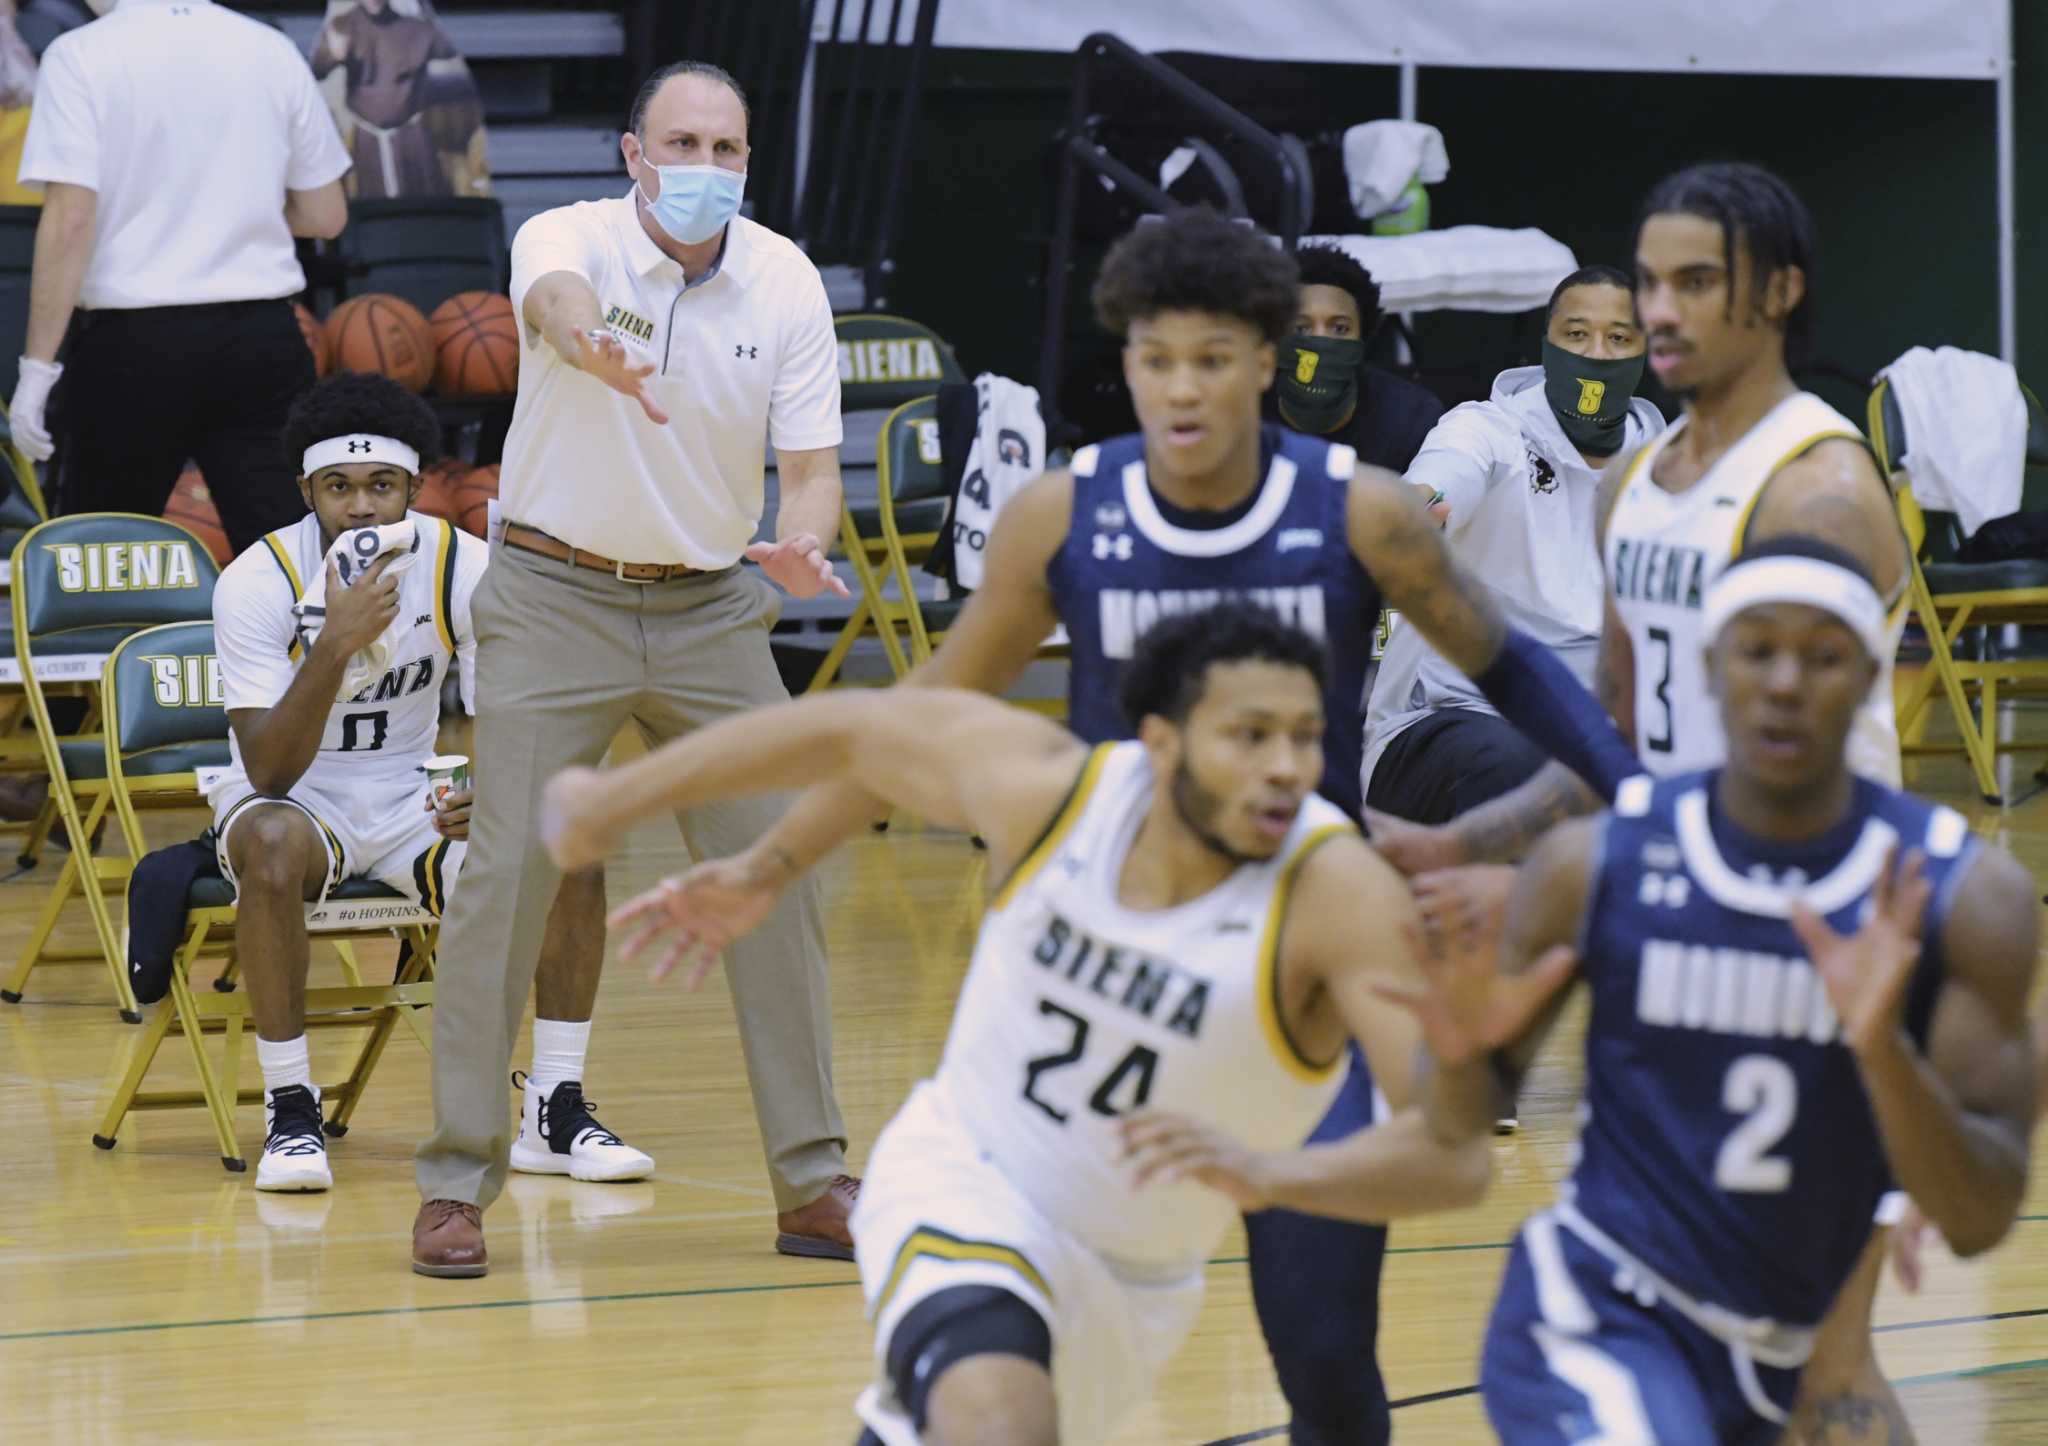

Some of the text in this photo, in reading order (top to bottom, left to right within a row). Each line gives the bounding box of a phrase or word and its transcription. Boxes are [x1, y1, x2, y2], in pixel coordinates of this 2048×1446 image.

[606, 304, 655, 341] SIENA
[1576, 377, 1606, 415] S
[42, 541, 199, 593] SIENA
[1616, 537, 1704, 610] SIENA
[137, 654, 225, 707] SIE
[346, 654, 435, 704] ENA
[1648, 626, 1674, 754] 3
[359, 906, 420, 919] HOPKINS
[1033, 914, 1212, 1038] SIENA
[1023, 998, 1158, 1124] 24
[1713, 1052, 1797, 1192] 2
